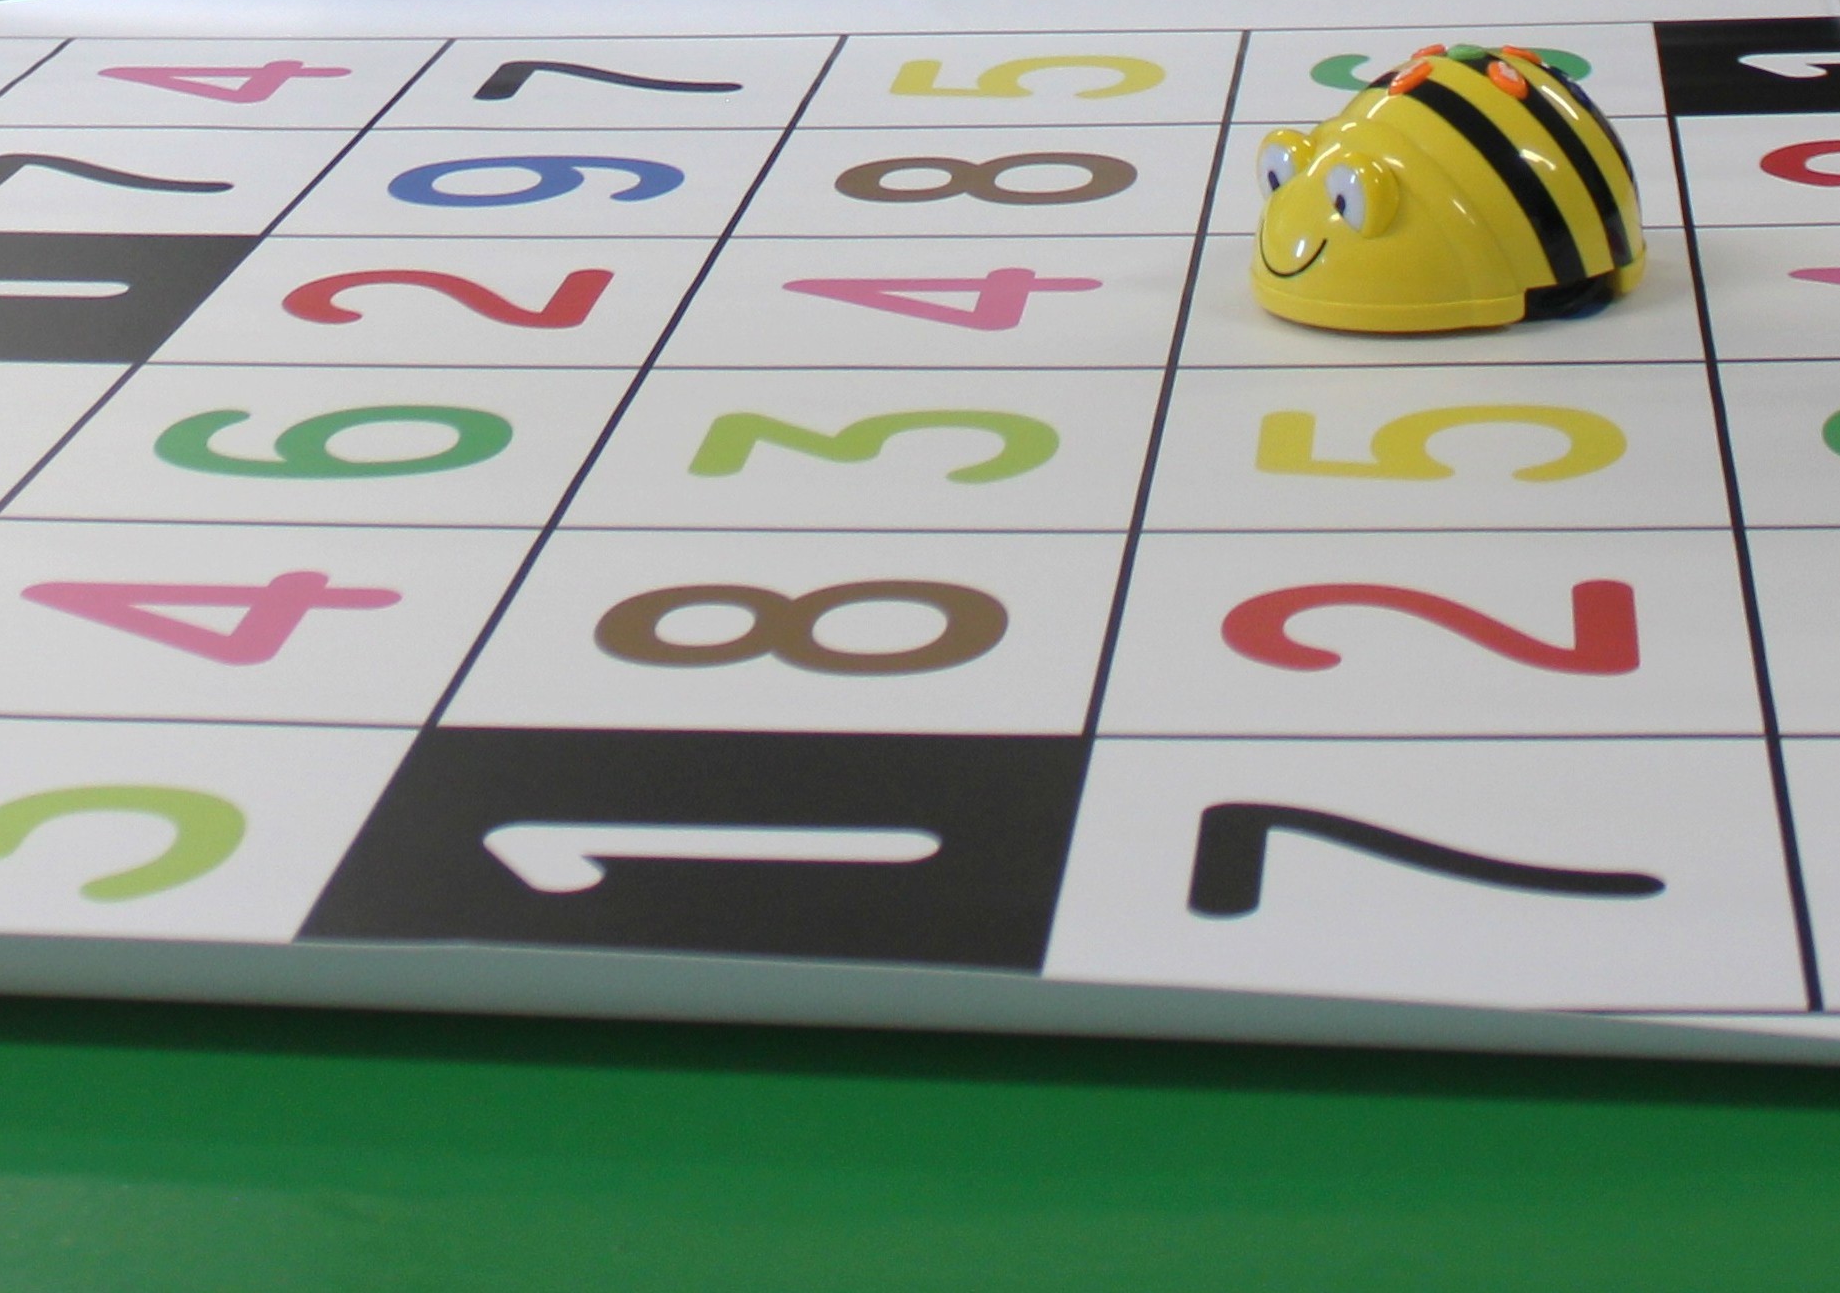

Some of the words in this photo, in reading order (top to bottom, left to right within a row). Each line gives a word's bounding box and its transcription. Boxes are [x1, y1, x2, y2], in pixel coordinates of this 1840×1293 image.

[101, 60, 350, 104] 4
[473, 60, 743, 101] 7
[889, 55, 1166, 99] 5
[387, 154, 685, 208] 9
[834, 151, 1137, 206] 8
[282, 268, 614, 328] 2
[782, 268, 1103, 331] 4
[157, 405, 513, 478] 6
[688, 409, 1060, 483] 3
[1255, 403, 1627, 481] 5
[21, 570, 401, 666] 4
[594, 580, 1009, 675] 8
[1221, 579, 1639, 674] 2
[482, 821, 942, 893] 1
[1186, 801, 1665, 918] 7
